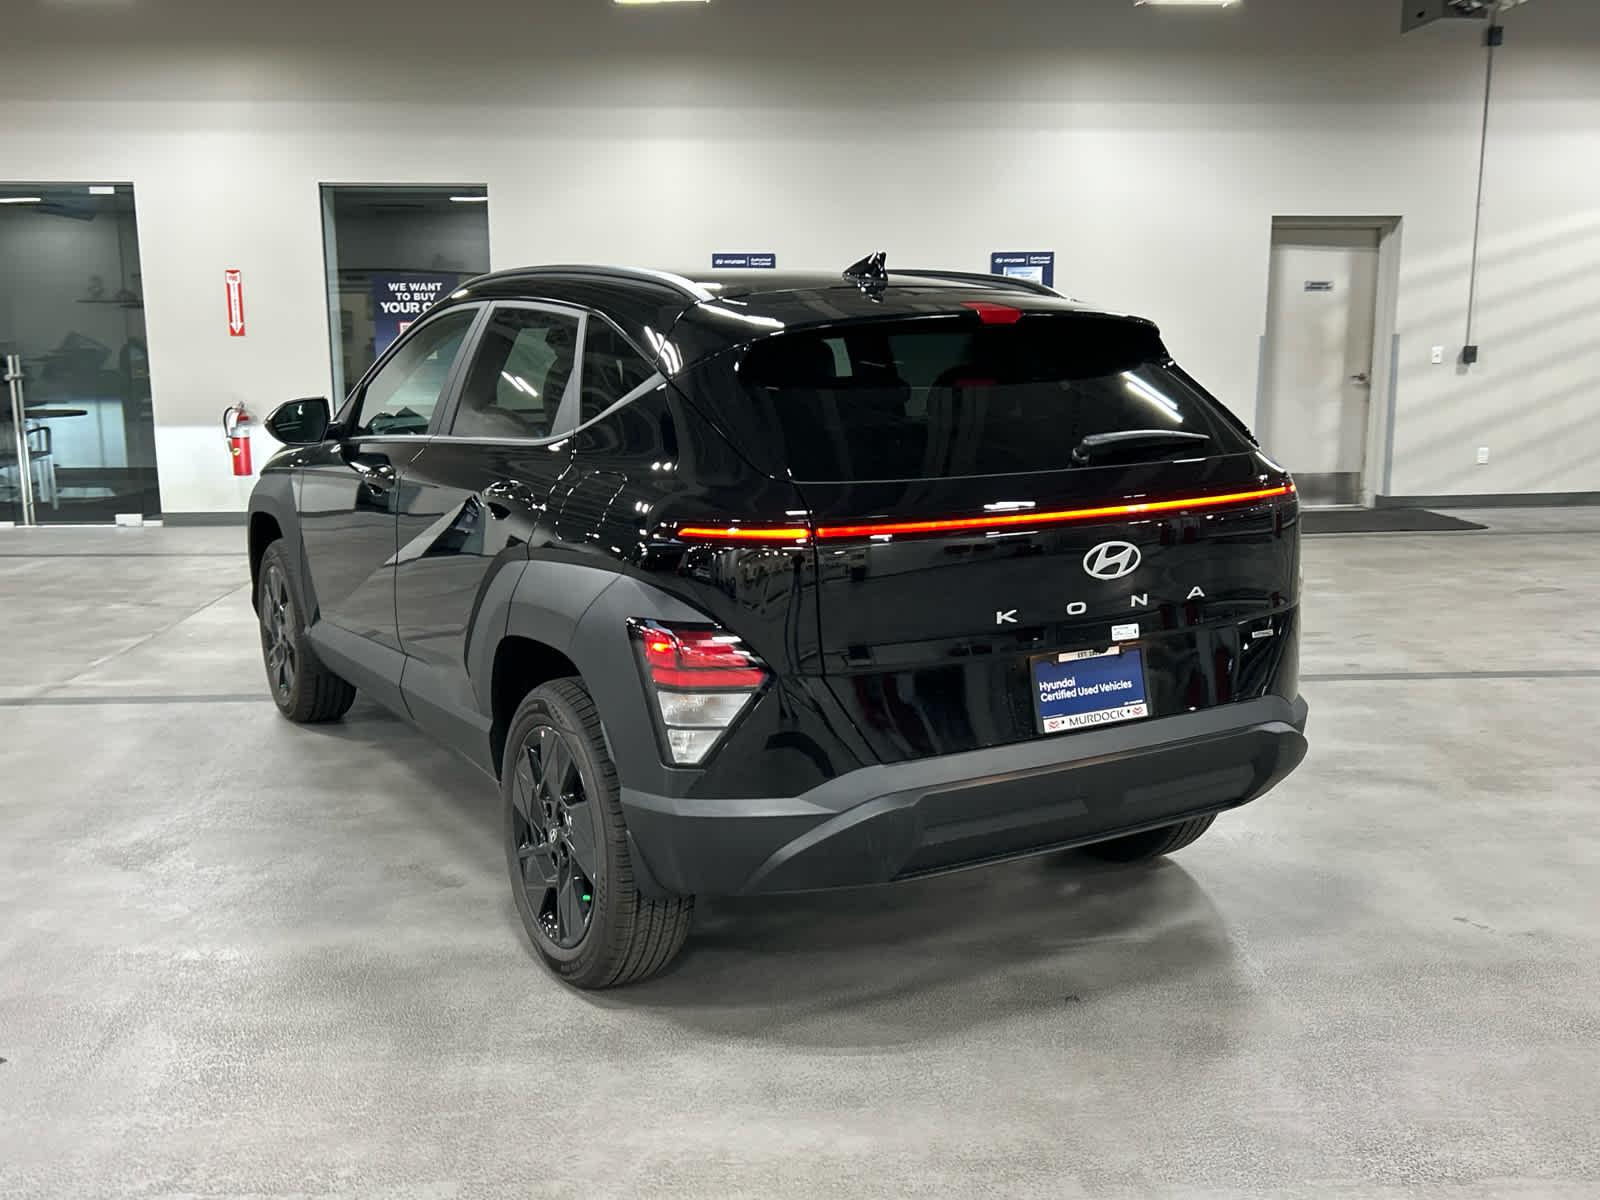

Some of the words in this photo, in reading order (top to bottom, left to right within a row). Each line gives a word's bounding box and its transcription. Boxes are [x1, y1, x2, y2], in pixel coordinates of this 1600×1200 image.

[387, 282, 407, 291] WE
[409, 282, 442, 291] WANT
[395, 292, 411, 301] TO
[413, 292, 436, 301] BUY
[380, 302, 420, 313] YOUR
[996, 586, 1205, 624] KONA
[1039, 677, 1075, 692] Hyundai
[1040, 687, 1077, 702] Certified
[1078, 684, 1099, 696] Used
[1099, 680, 1133, 693] Vehicles
[1069, 710, 1125, 727] MURDOCK
